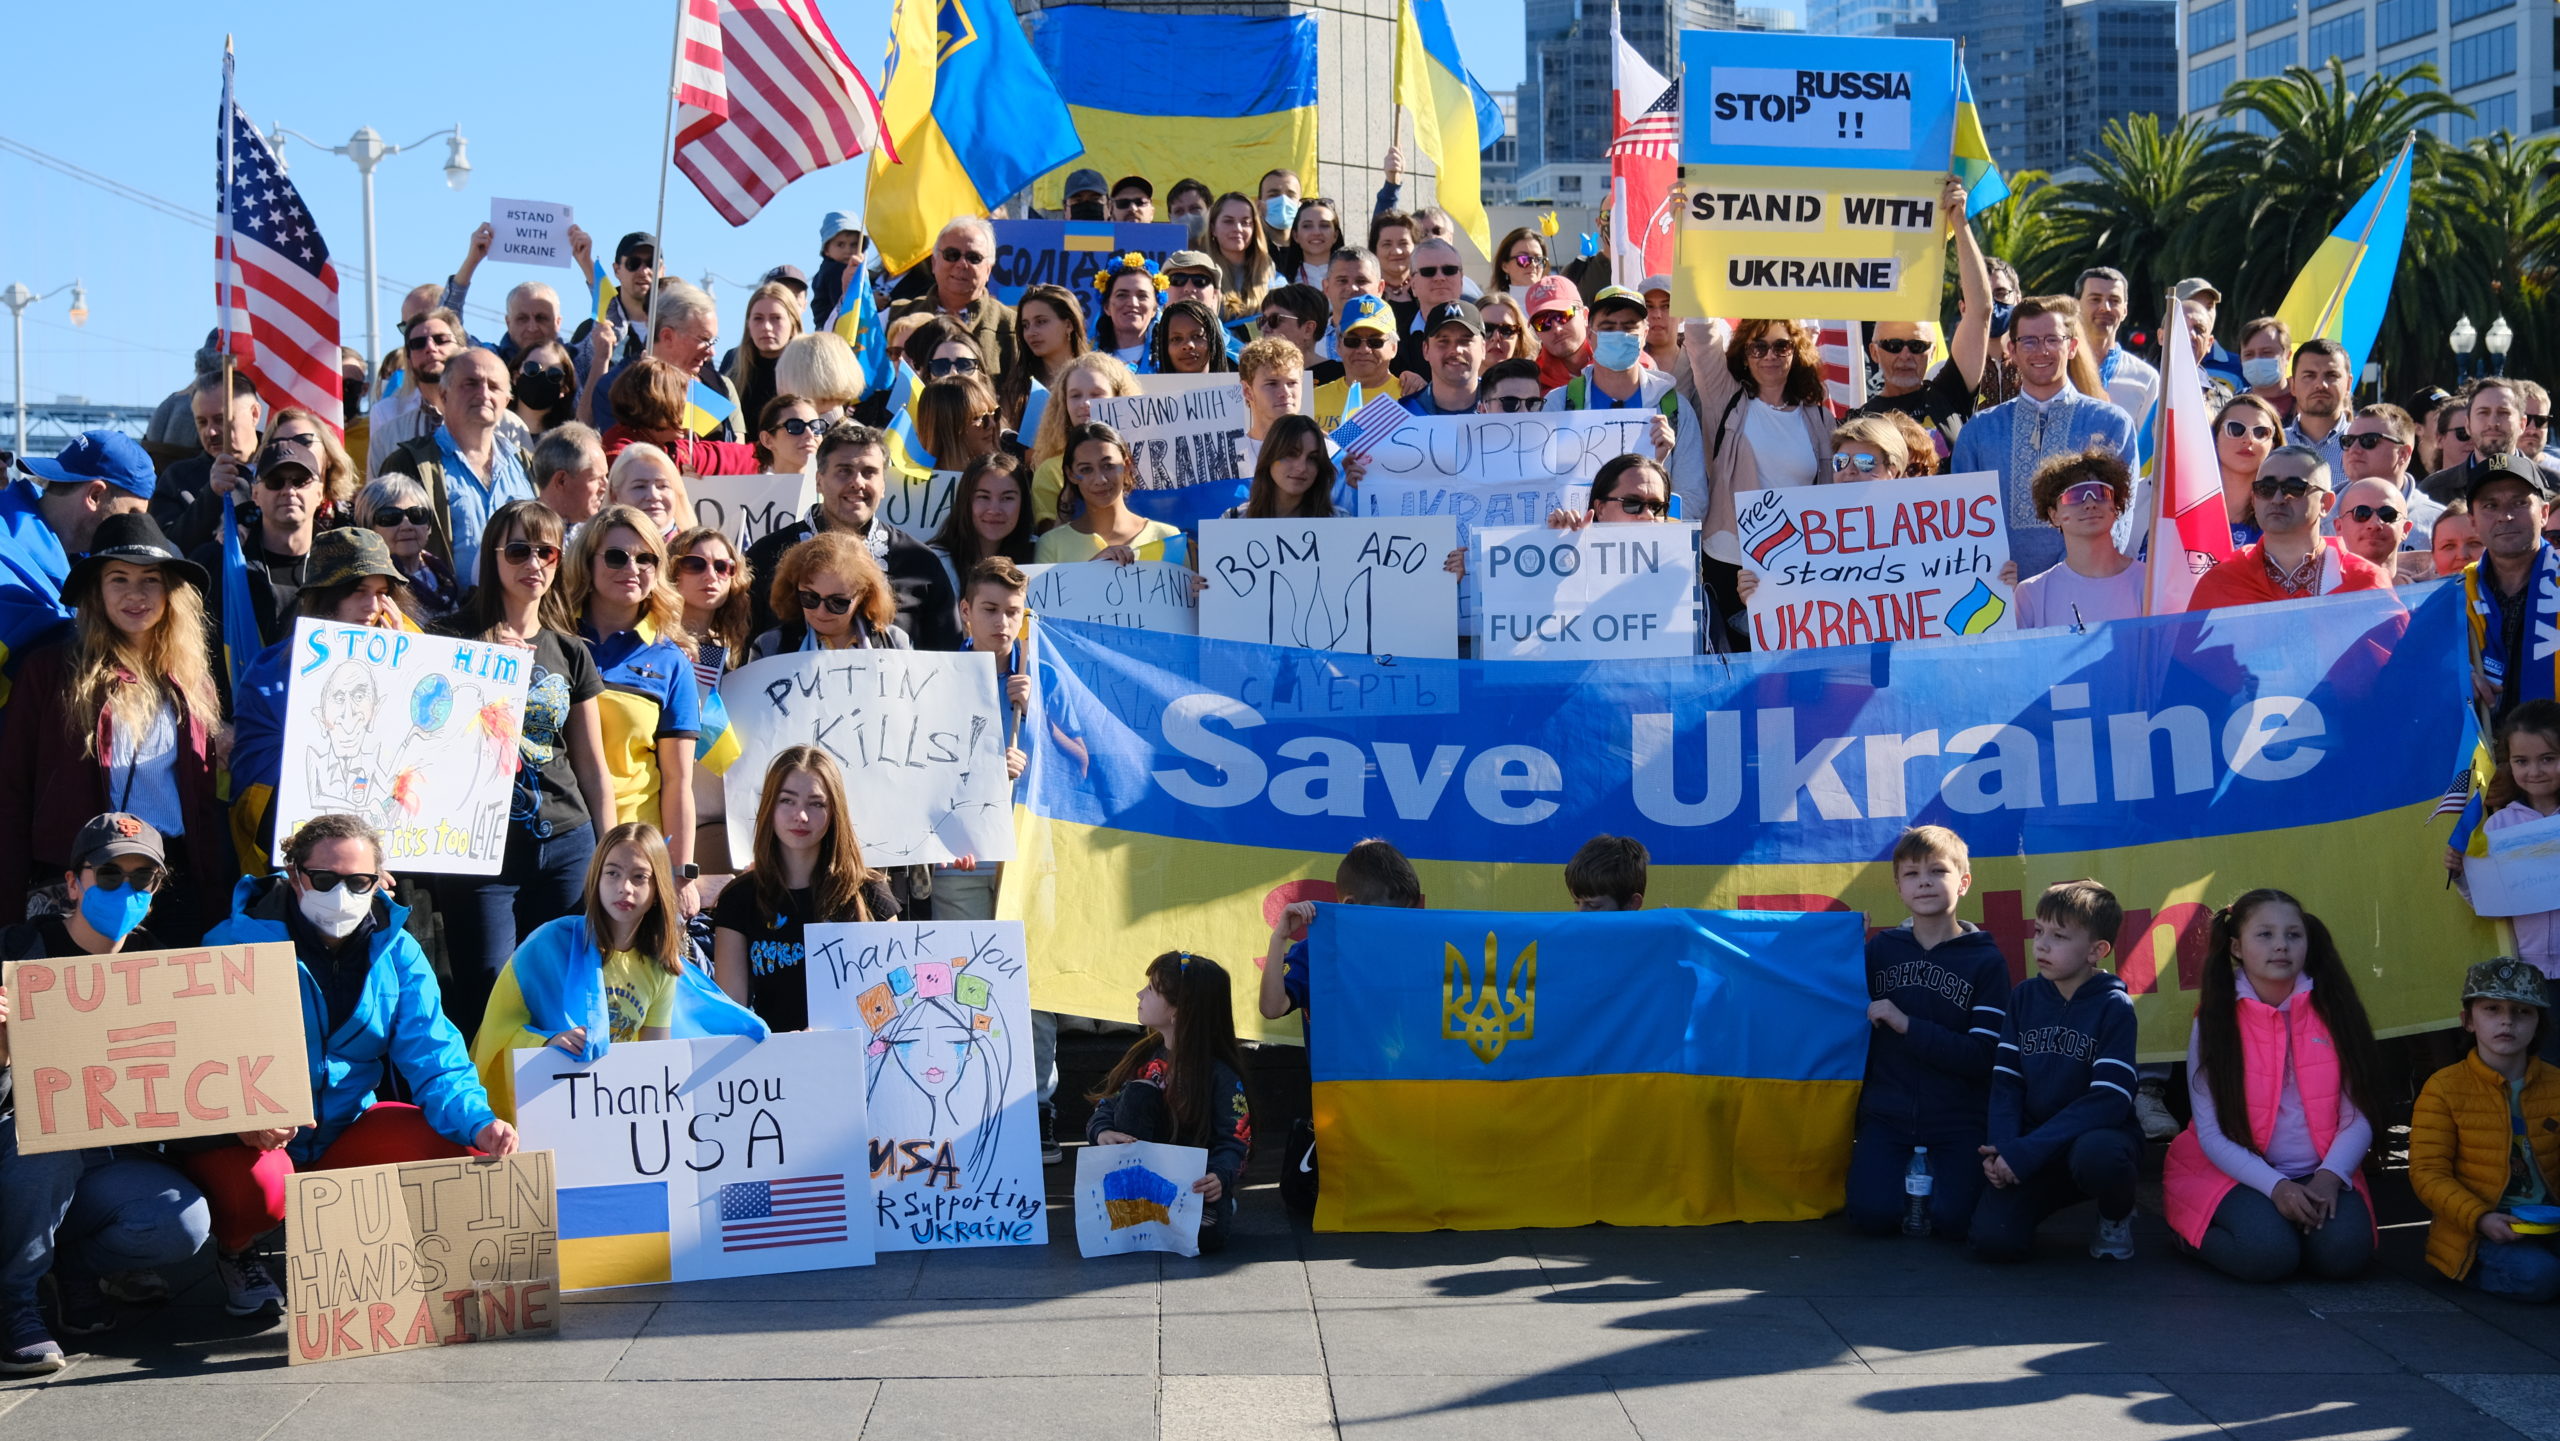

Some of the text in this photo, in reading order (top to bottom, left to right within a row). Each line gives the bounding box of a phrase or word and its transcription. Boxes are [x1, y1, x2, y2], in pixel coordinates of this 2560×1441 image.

[1714, 70, 1911, 123] STOP RUSSIA
[507, 210, 554, 223] #STAND
[516, 227, 547, 240] WITH
[1692, 192, 1933, 228] STAND WITH
[504, 243, 556, 258] UKRAINE
[1729, 259, 1891, 289] UKRAINE
[1099, 388, 1226, 430] WE STAND WITH
[1128, 428, 1245, 491] KRAINE
[1381, 420, 1650, 478] SUPPORT
[1738, 490, 1782, 536] Free
[1800, 494, 1997, 555] BELARUS
[1216, 531, 1427, 597] ВОЛЯ АБО
[1489, 541, 1659, 578] POO TIN
[1776, 545, 1991, 585] stands with
[1027, 566, 1196, 609] WE STAND
[1491, 613, 1657, 642] FUCK OFF
[1754, 589, 1942, 651] UKRAINE
[301, 624, 412, 679] STOP
[1151, 694, 1563, 825] Save
[1631, 682, 2326, 827] Ukraine
[17, 947, 255, 1020] PUTIN
[813, 924, 936, 989] Thank
[1874, 960, 1974, 1012] OSHKOSH
[34, 1055, 288, 1134] PRICK
[552, 1066, 786, 1119] Thank you
[630, 1109, 784, 1176] USA
[867, 1137, 962, 1192] USA
[300, 1153, 550, 1253] PUTIN
[291, 1231, 556, 1313] HANDS OFF
[296, 1283, 552, 1361] UKRAINE
